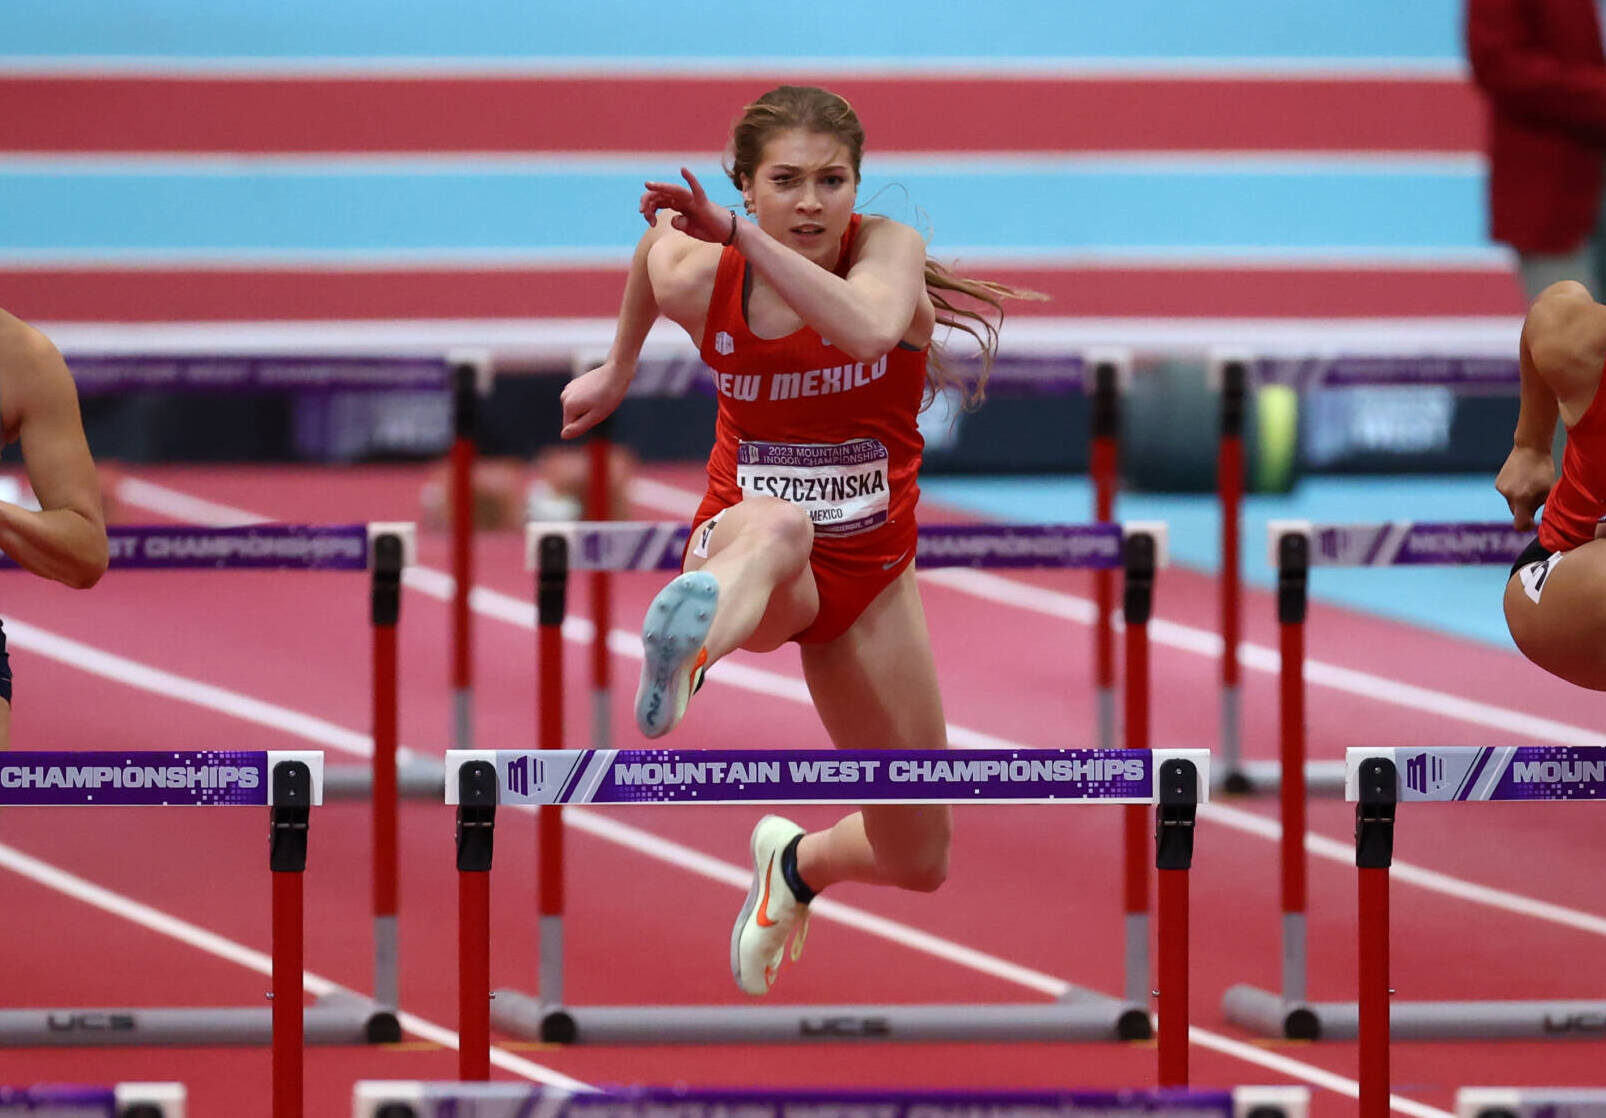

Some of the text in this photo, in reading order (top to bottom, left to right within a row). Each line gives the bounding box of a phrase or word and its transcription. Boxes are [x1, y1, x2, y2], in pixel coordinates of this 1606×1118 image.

[763, 448, 886, 466] INDOOR CHAMPIONSHIPS
[768, 446, 794, 457] 2023
[796, 444, 850, 458] MOUNTAIN
[0, 766, 260, 790] CHAMPIONSHIPS
[614, 759, 1145, 786] MOUNTAIN WEST CHAMPIONSHIPS
[1513, 761, 1606, 783] MOUN
[799, 1016, 891, 1037] UCS
